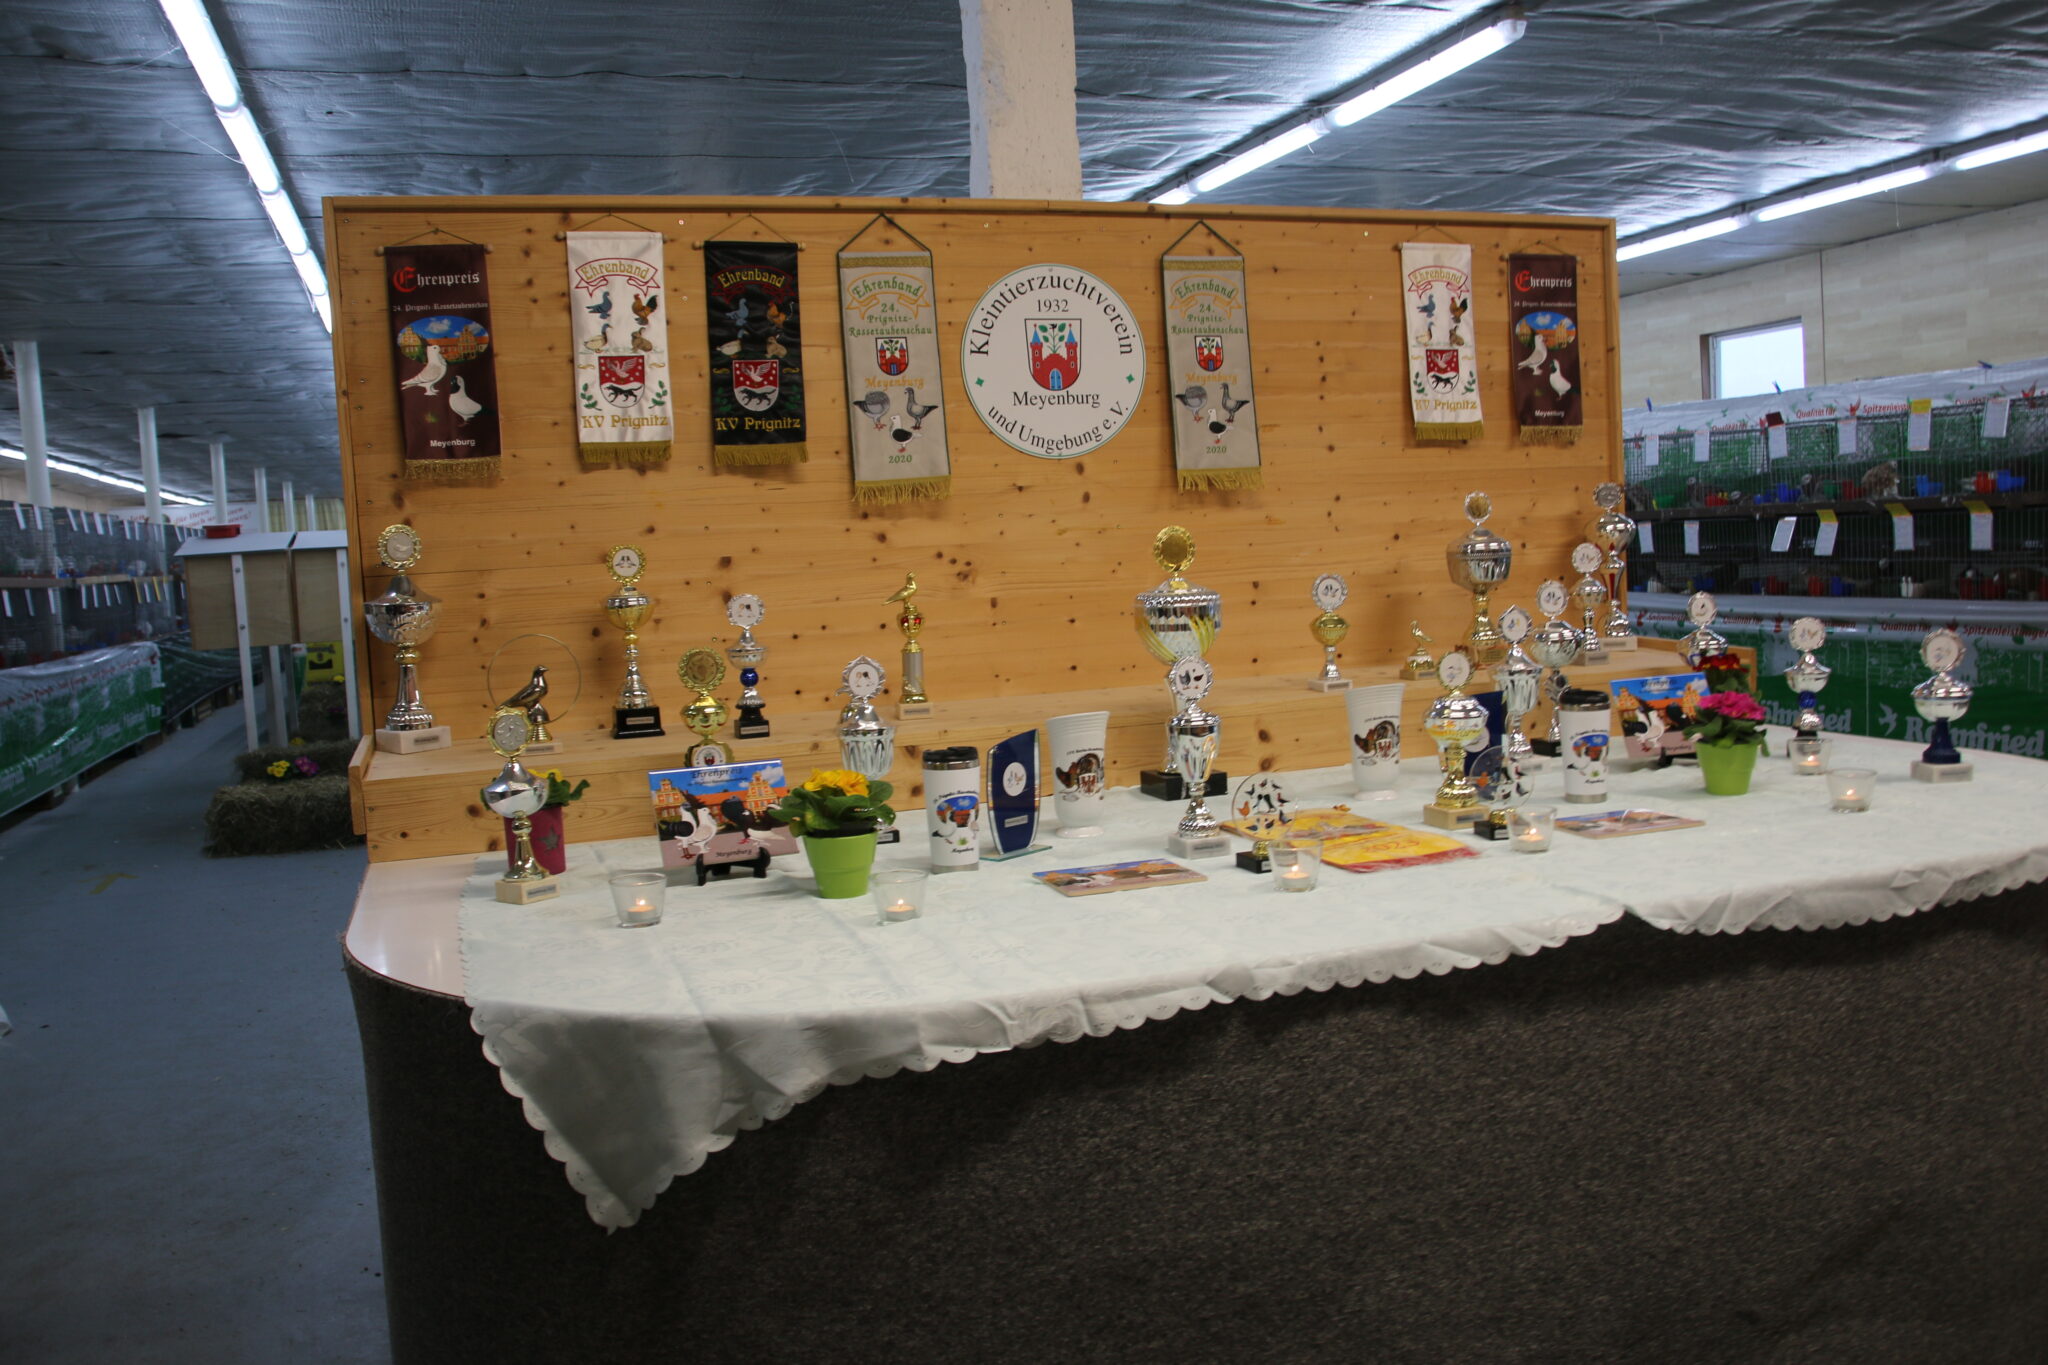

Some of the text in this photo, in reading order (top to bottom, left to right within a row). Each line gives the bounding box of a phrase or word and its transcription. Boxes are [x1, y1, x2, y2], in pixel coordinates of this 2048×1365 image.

[580, 261, 649, 280] Ehrenband
[717, 268, 785, 288] Ehrenband
[392, 266, 480, 293] Ehrenpreis
[852, 276, 922, 298] Ehrenband
[1515, 269, 1573, 292] Ehrenpreis
[1174, 278, 1235, 299] Ehrenband
[881, 303, 899, 313] 24.
[1036, 299, 1069, 312] 1932
[970, 274, 1136, 356] Kleintierzuchtverein
[864, 376, 924, 391] Meyenburg
[1012, 390, 1101, 410] Meyenburg
[1434, 400, 1477, 412] Prignitz
[581, 414, 669, 429] KV Prignitz
[715, 416, 801, 432] KV Prignitz
[987, 406, 1018, 434] und
[1018, 425, 1102, 454] Umgebung
[430, 439, 476, 448] Meyenburg
[1206, 446, 1227, 454] 2020
[889, 454, 912, 464] 2020
